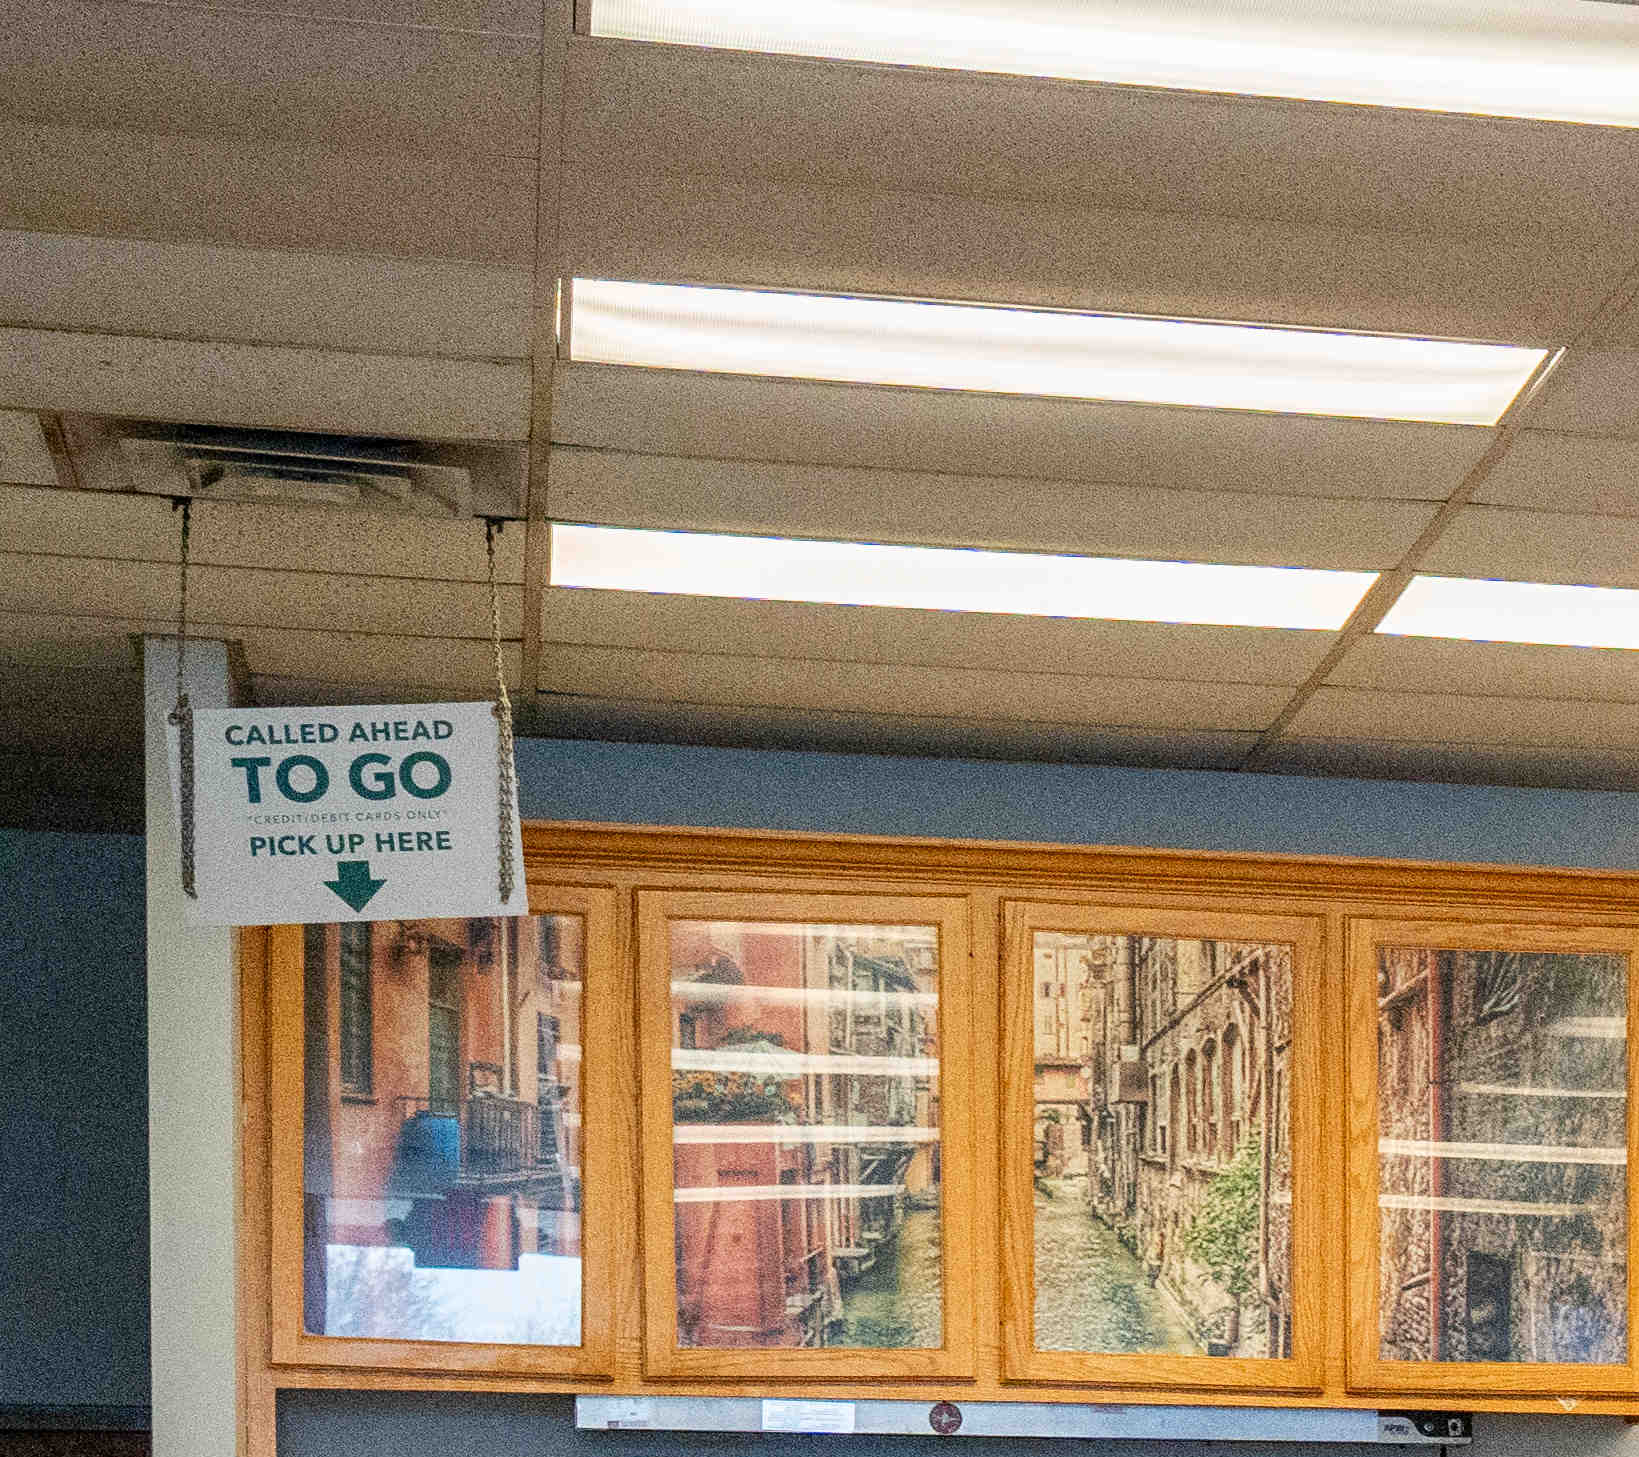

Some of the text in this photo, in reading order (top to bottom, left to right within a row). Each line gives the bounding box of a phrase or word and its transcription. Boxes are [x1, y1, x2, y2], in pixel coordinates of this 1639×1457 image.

[224, 719, 454, 746] CALLED AHEAD
[230, 750, 453, 804] TO GO
[250, 830, 453, 857] PICK UP HERE
